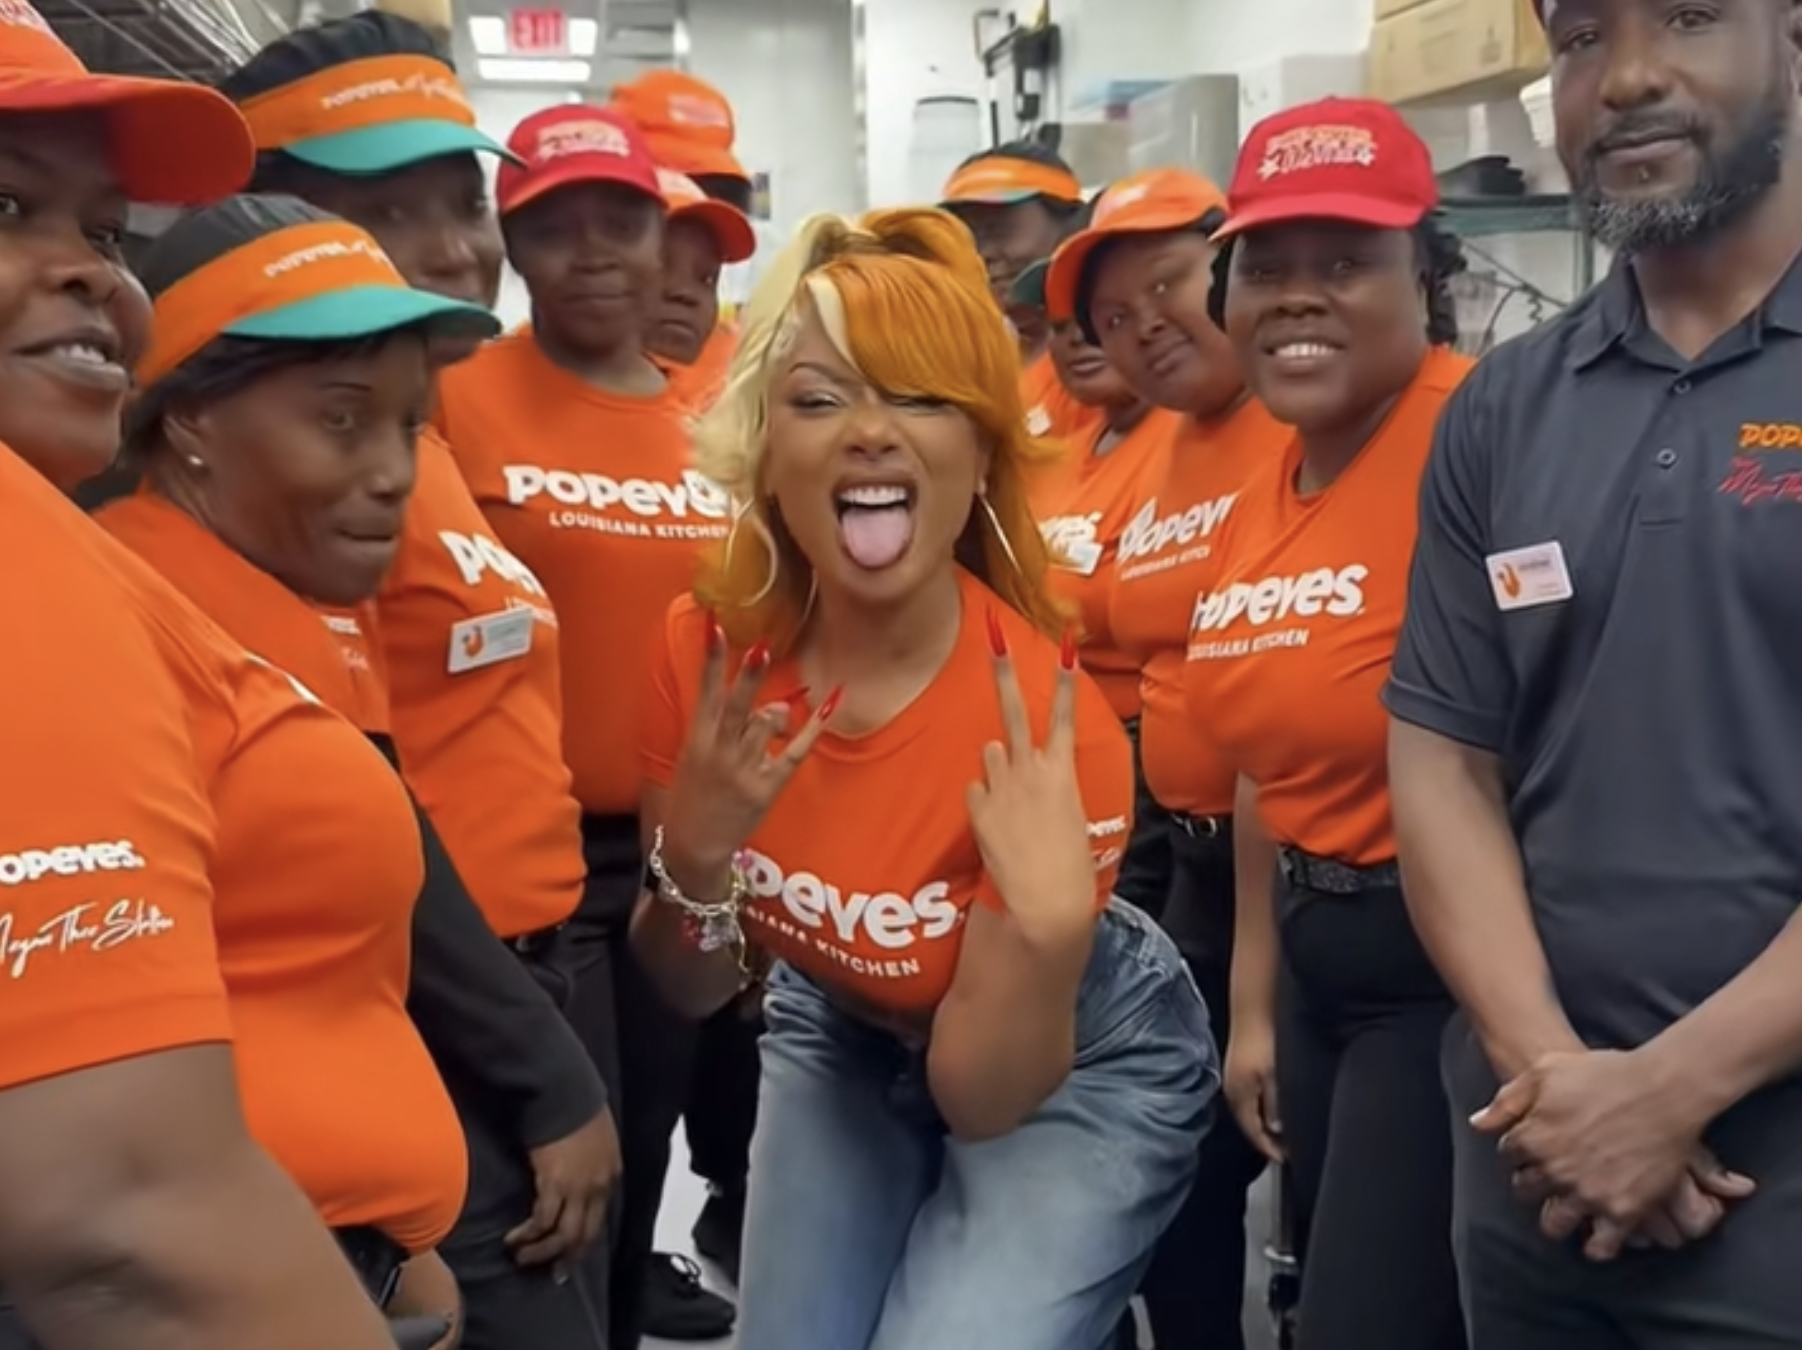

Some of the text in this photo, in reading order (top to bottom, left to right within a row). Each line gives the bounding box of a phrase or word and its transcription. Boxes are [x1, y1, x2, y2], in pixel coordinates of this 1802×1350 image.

[511, 10, 562, 49] EXIT
[549, 511, 652, 537] LOUISIANA
[815, 937, 921, 978] KITCHEN
